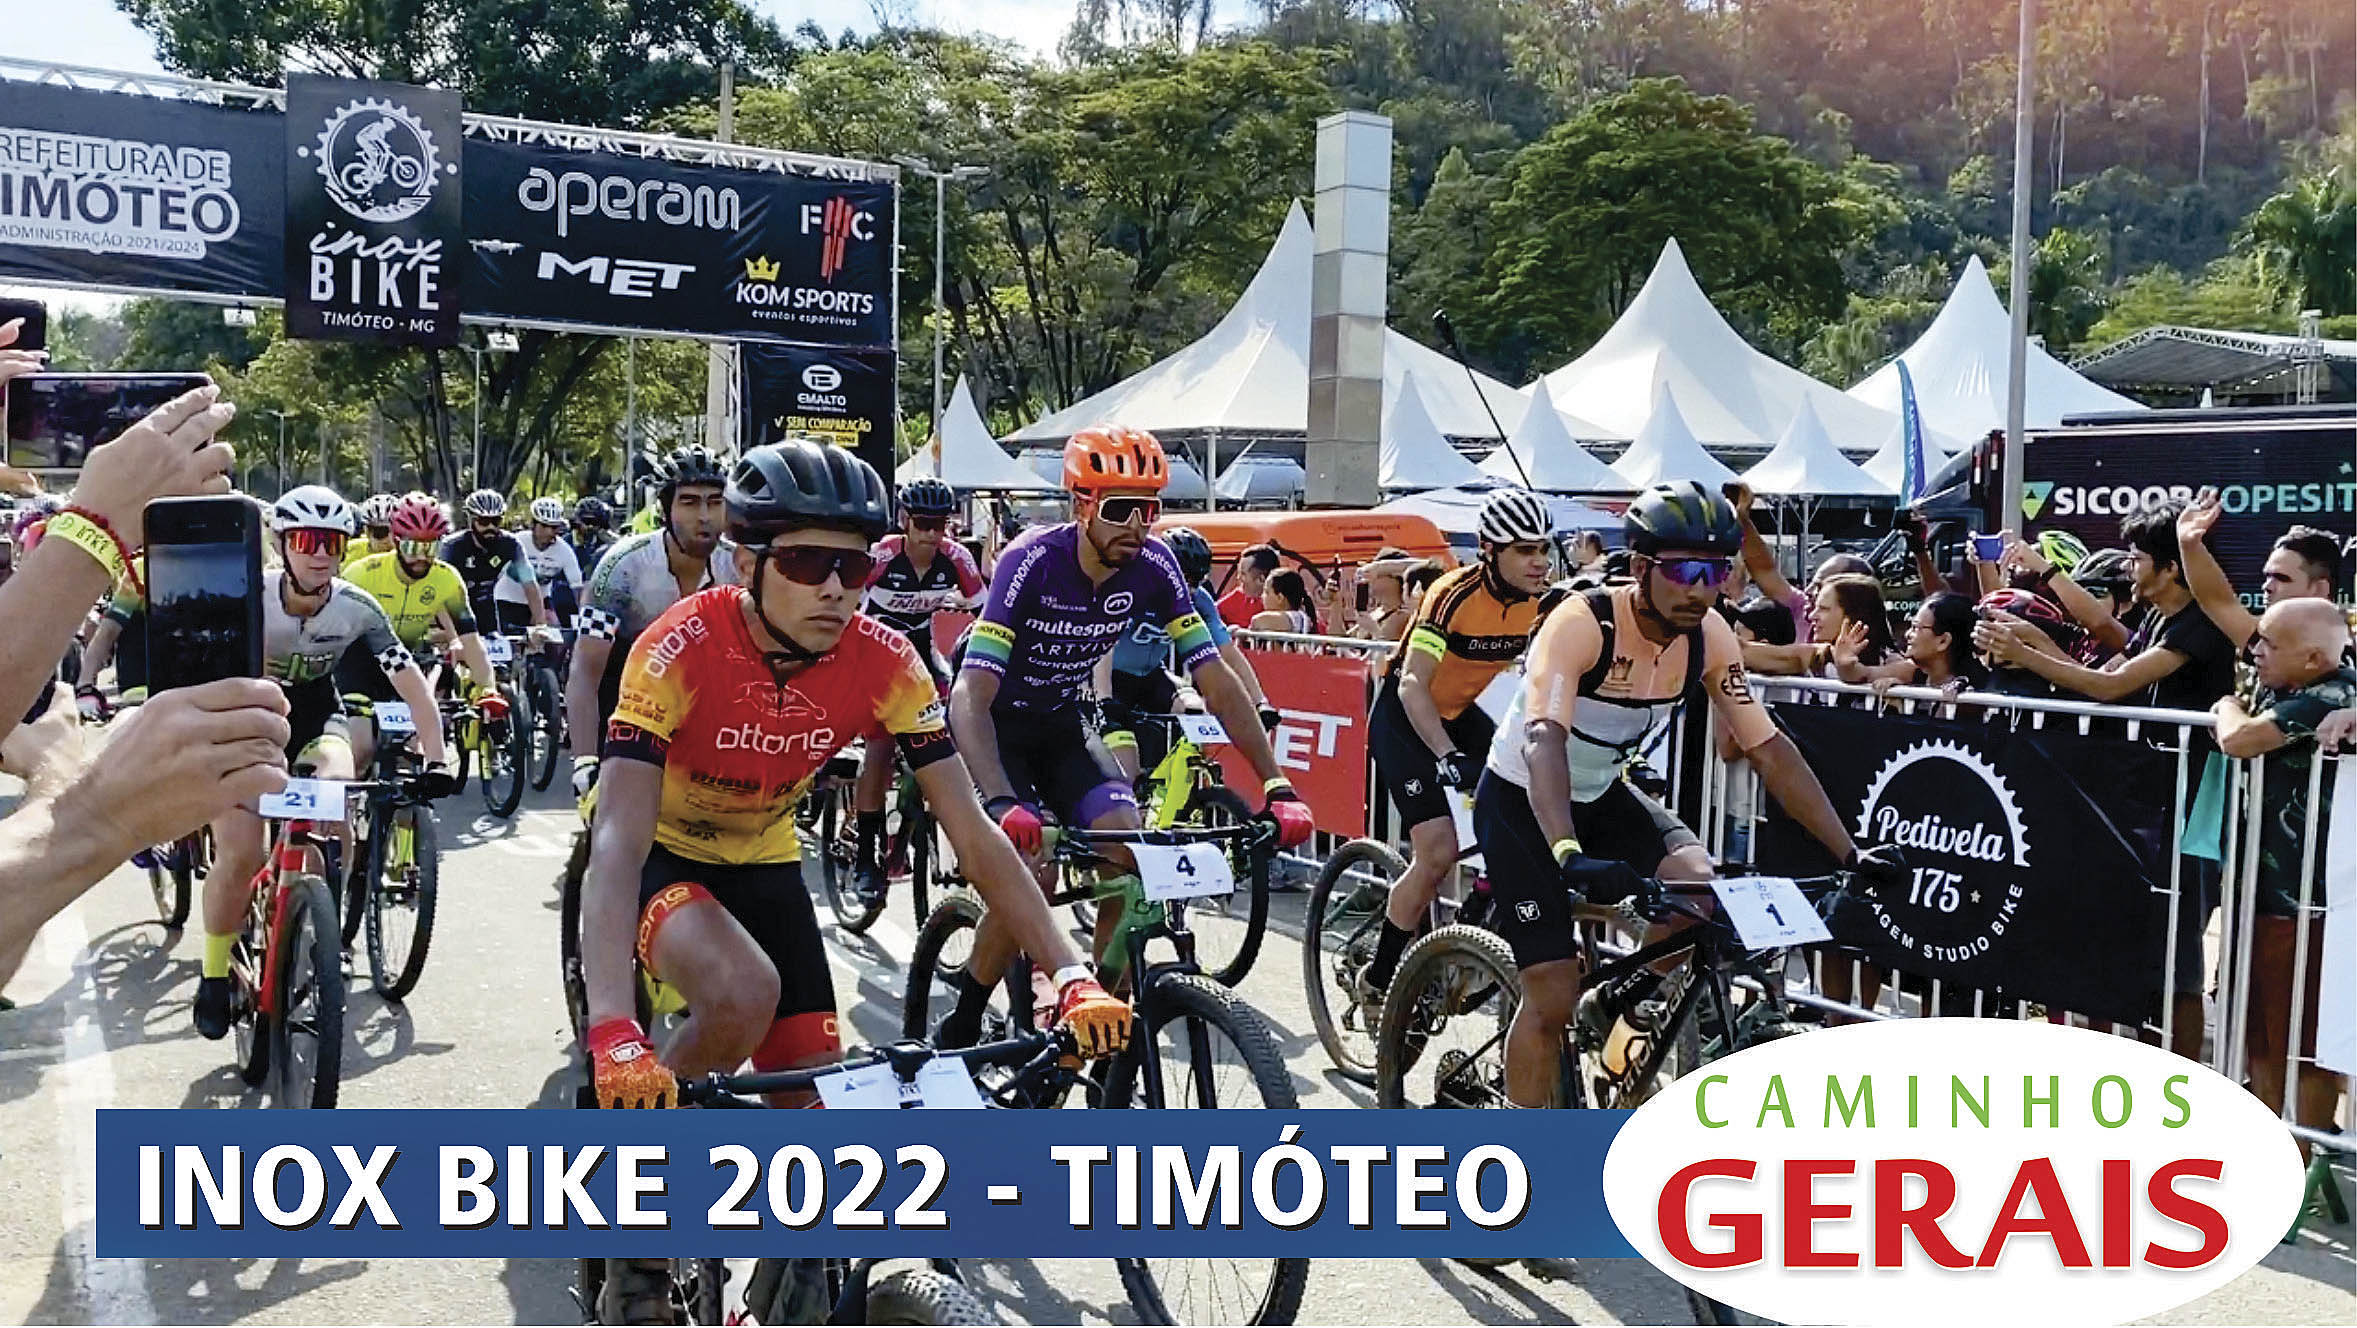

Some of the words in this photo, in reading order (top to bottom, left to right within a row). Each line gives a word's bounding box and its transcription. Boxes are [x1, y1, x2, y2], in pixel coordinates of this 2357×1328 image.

[183, 152, 224, 183] DE
[518, 167, 740, 237] aperam
[309, 221, 442, 272] inox
[310, 254, 440, 311] BIKE
[537, 251, 697, 297] MET
[736, 282, 790, 307] KOM
[793, 288, 874, 314] SPORTS
[321, 311, 394, 330] TIMÓTEO
[409, 318, 436, 333] MG
[752, 310, 796, 322] eventos
[797, 392, 847, 406] EMALTO
[2202, 483, 2355, 515] OPESIT
[1273, 708, 1352, 771] ET
[285, 792, 317, 809] 21
[1876, 805, 2006, 862] Pedivela
[1176, 854, 1195, 877] 4
[1909, 867, 1963, 912] 175
[1765, 903, 1786, 927] 1
[1923, 936, 1989, 962] STUDIO
[1991, 884, 2023, 935] BIKE
